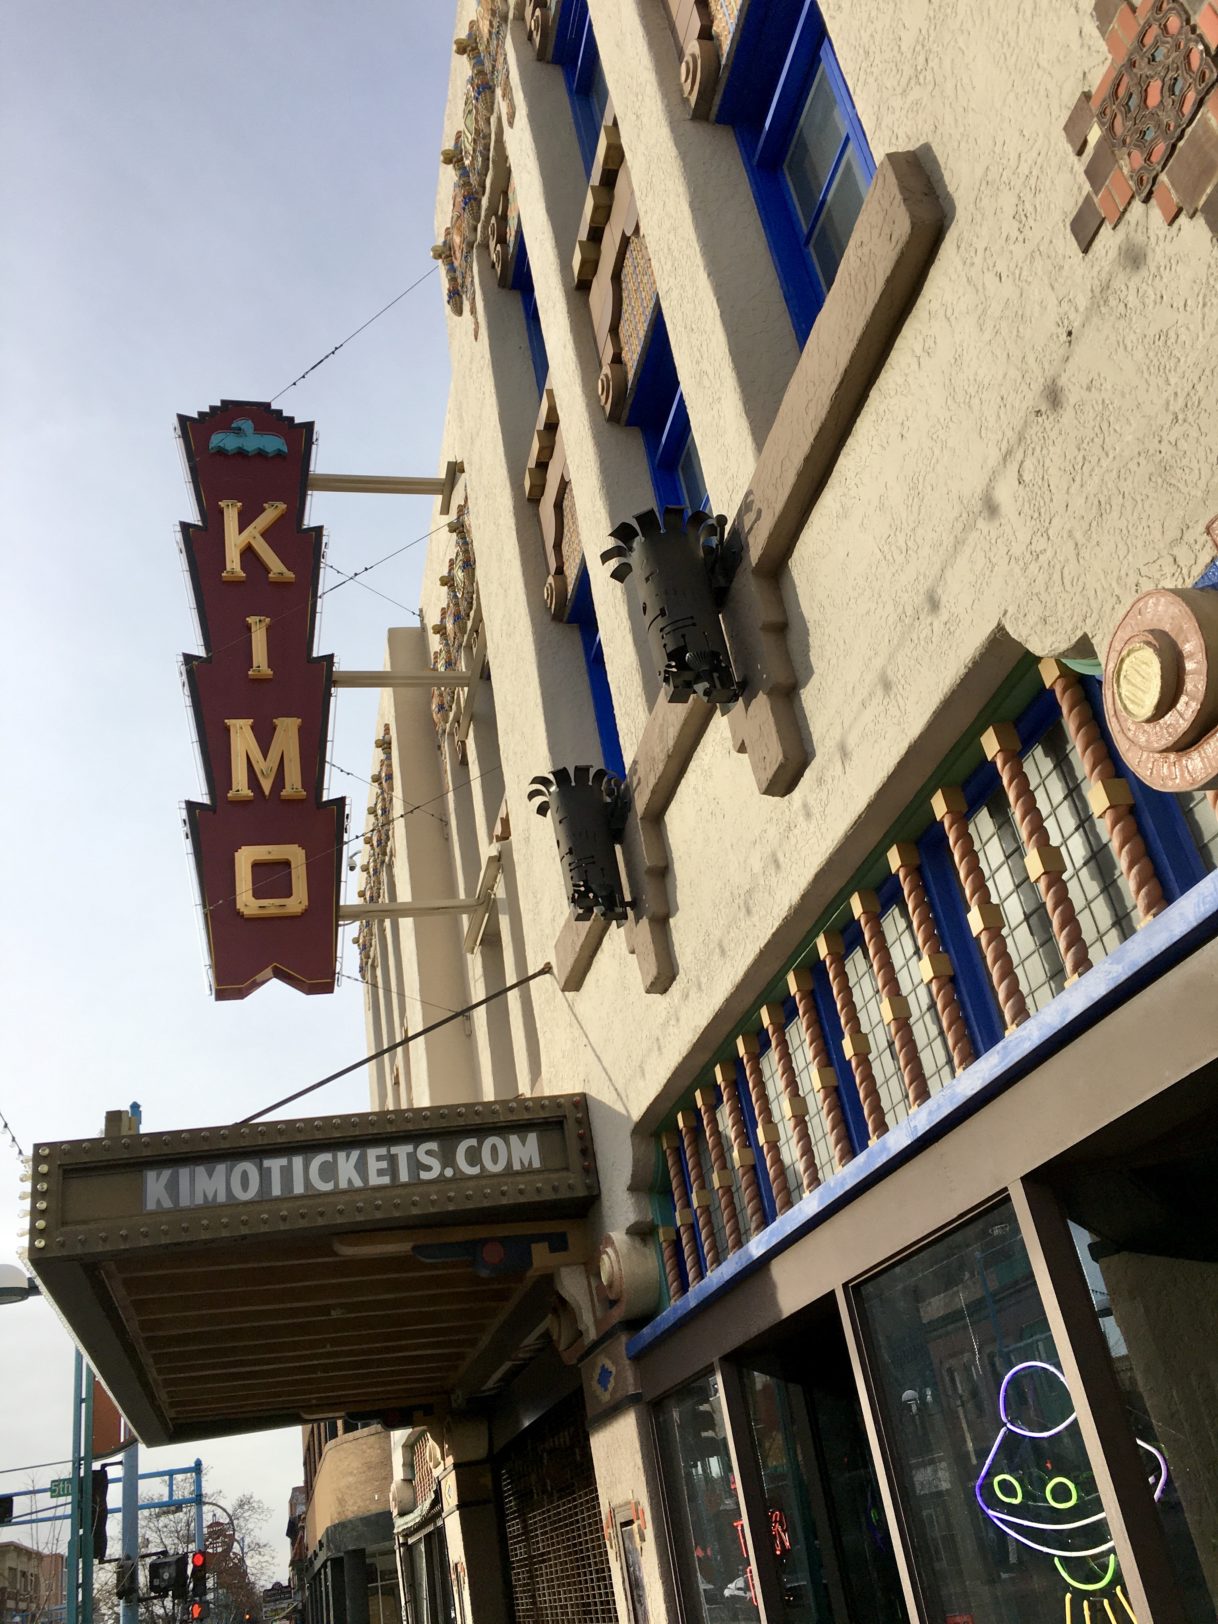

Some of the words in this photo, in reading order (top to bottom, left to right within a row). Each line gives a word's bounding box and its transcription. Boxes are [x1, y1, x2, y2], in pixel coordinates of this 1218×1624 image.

[218, 500, 309, 919] KIMO
[145, 1132, 542, 1210] KIMOTICKETS.COM
[52, 1481, 71, 1495] 5th
